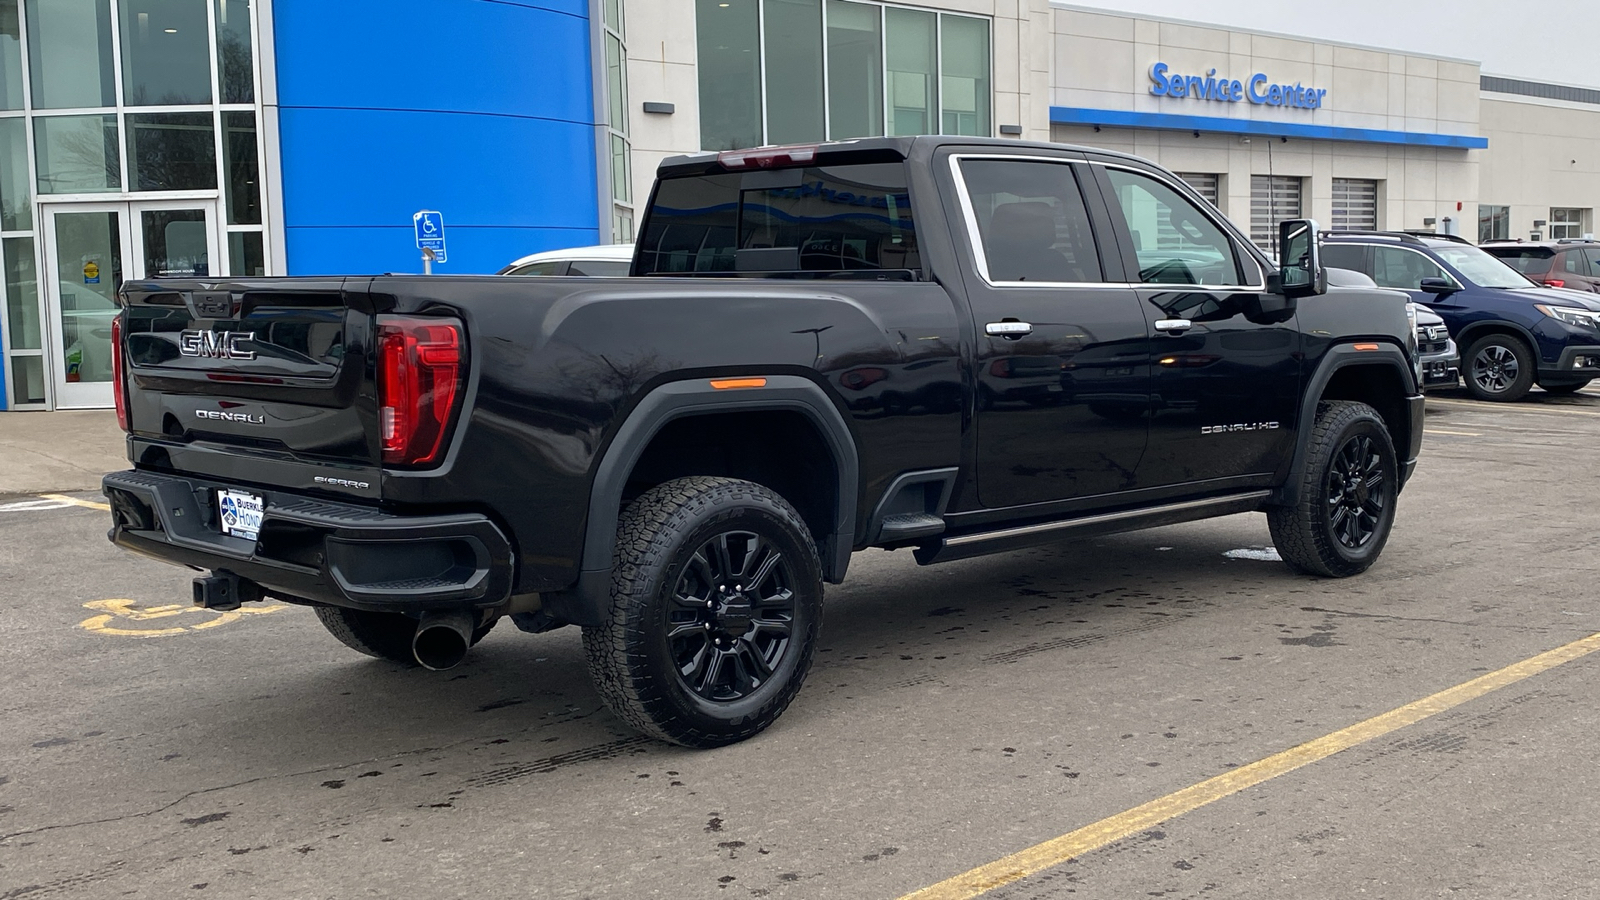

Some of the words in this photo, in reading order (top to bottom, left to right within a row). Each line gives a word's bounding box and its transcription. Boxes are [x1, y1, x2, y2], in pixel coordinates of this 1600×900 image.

[1149, 61, 1243, 103] Service
[1246, 72, 1327, 110] Center
[178, 328, 258, 361] GMC
[195, 409, 265, 424] DENALI
[1201, 422, 1257, 434] DENALI
[1258, 421, 1280, 430] HD
[313, 476, 369, 489] SIERRA
[236, 497, 264, 512] BUERKLE
[238, 509, 261, 528] HOND
